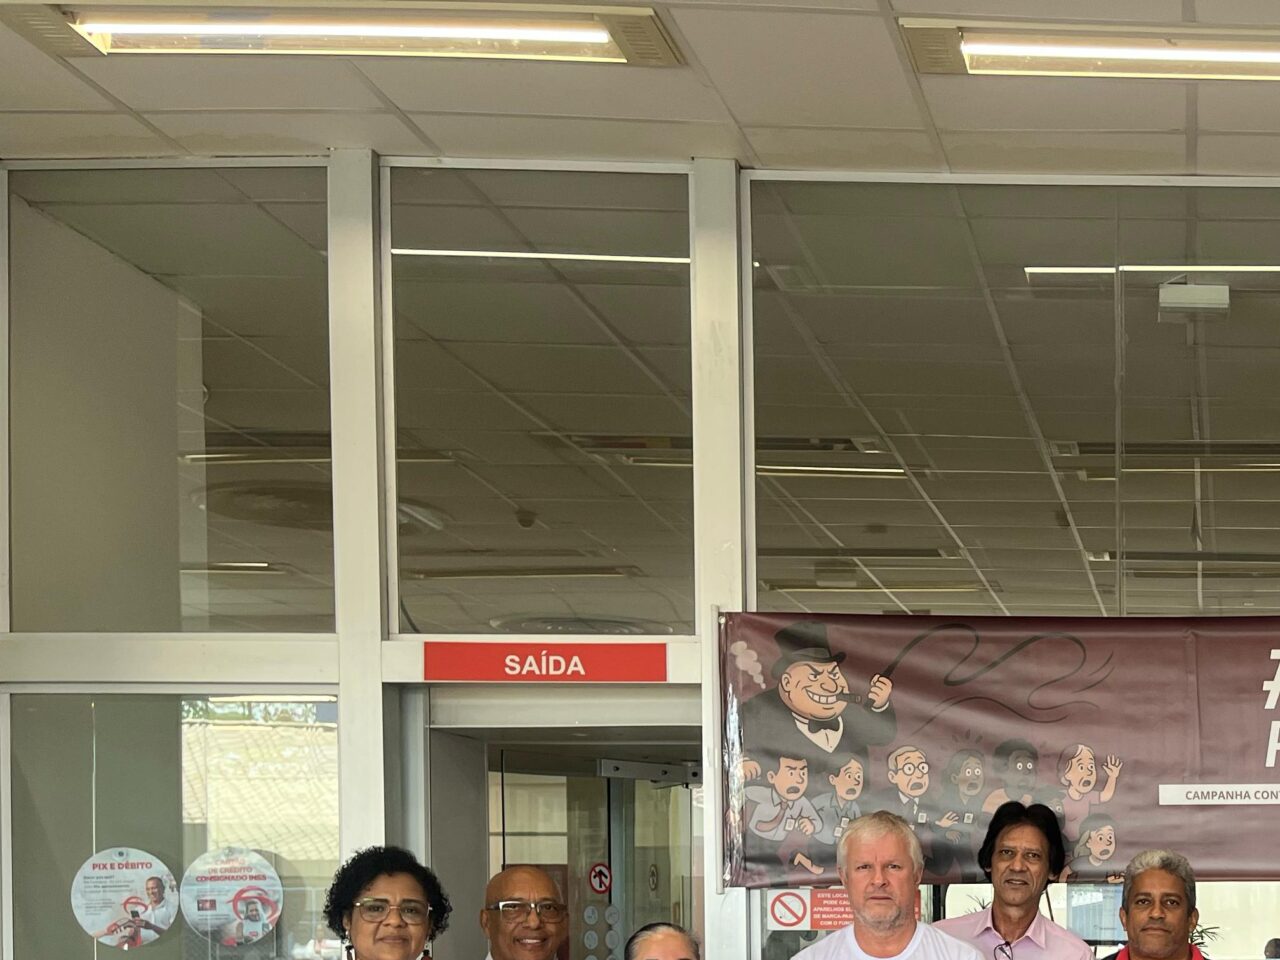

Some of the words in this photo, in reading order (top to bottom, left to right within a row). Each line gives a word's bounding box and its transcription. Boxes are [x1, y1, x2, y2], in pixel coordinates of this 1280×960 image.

[504, 650, 586, 675] SAÍDA
[1185, 790, 1251, 800] CAMPANHA
[118, 861, 152, 870] DÉBITO
